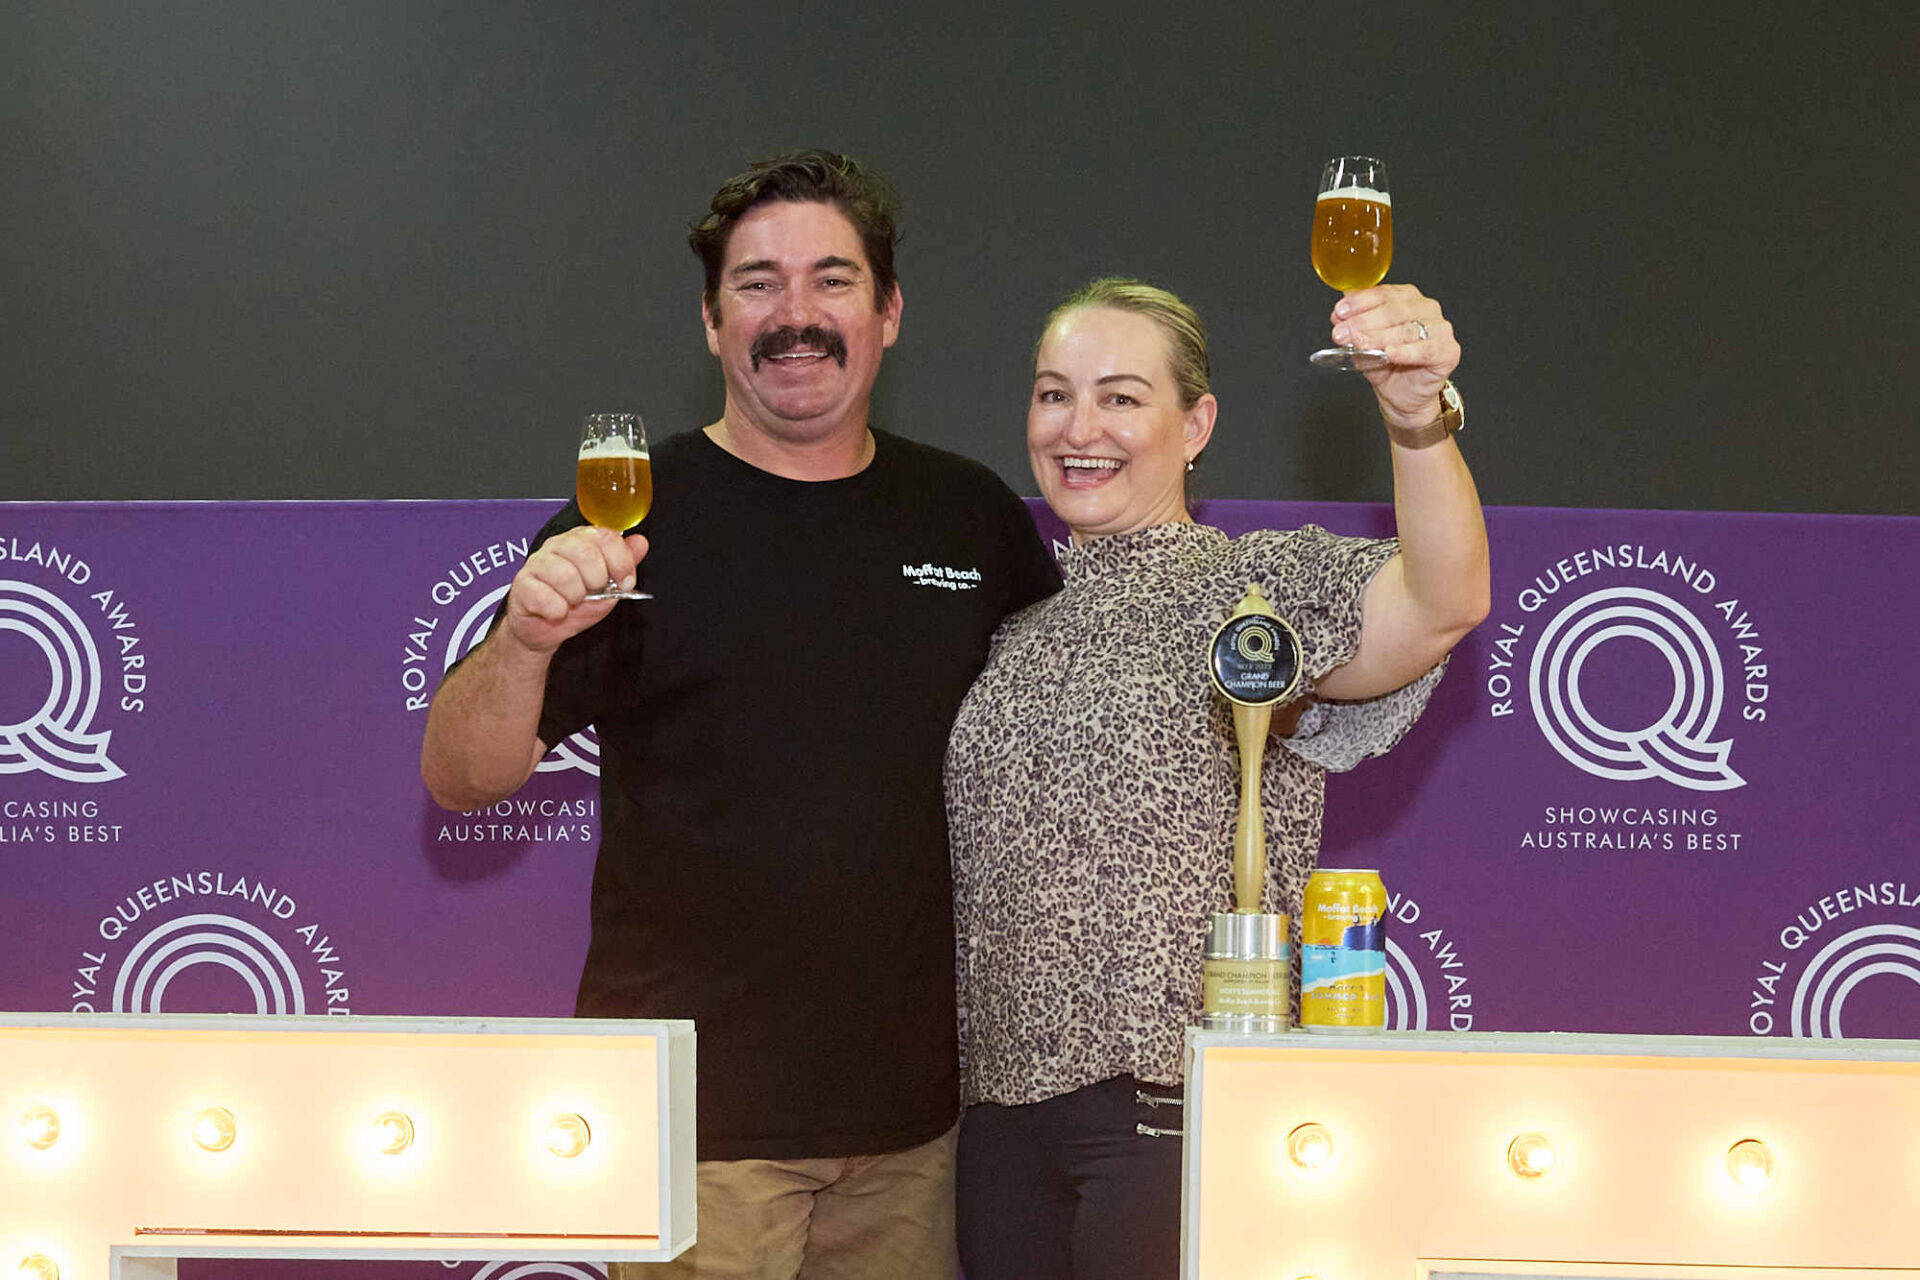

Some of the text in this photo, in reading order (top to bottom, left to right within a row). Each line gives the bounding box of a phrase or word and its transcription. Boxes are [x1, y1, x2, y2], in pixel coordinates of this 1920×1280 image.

[902, 563, 981, 581] Moffat Beach
[1488, 544, 1768, 722] ROYAL QUEENSLAND AWARDS
[90, 590, 147, 713] AWARDS
[402, 616, 439, 711] ROYAL
[1224, 681, 1286, 689] CHAMPION BEER
[1241, 672, 1269, 680] GRAND
[4, 801, 98, 818] CASING
[1545, 807, 1718, 825] SHOWCASING
[69, 826, 122, 842] BEST
[438, 824, 591, 842] AUSTRALIA'S
[1521, 832, 1742, 850] AUSTRALIA'S BEST
[99, 871, 296, 940] QUEENSLAND
